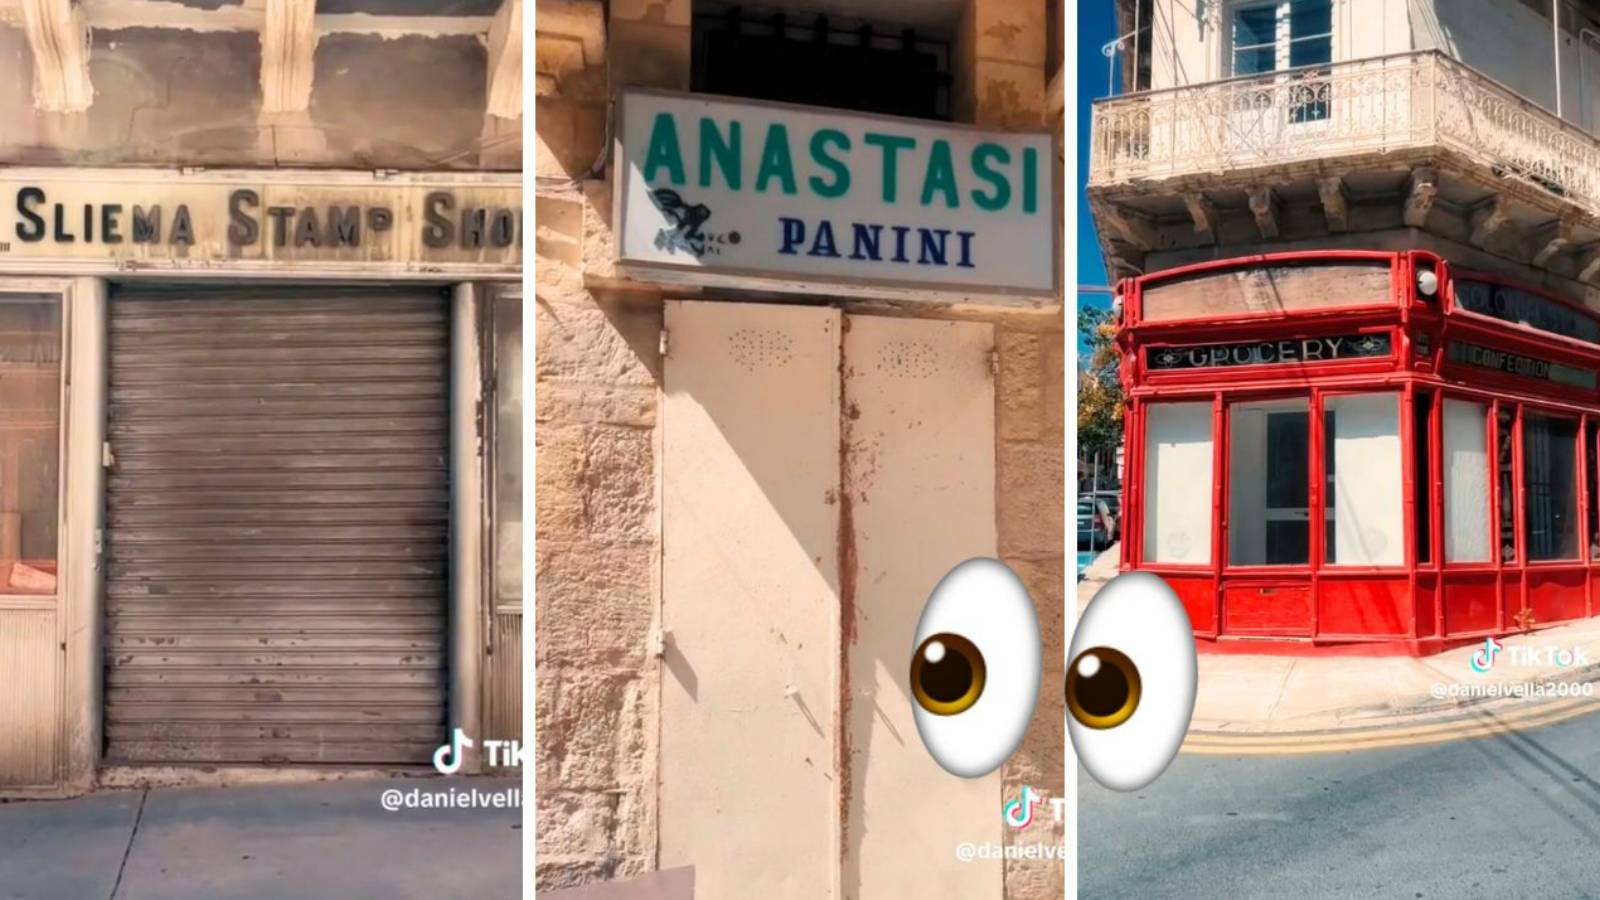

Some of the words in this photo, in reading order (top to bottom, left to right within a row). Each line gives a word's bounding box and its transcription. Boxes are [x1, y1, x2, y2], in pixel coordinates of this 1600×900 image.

[644, 112, 1038, 214] ANASTASI
[15, 186, 196, 244] SLIEMA
[227, 189, 393, 248] STAMP
[422, 191, 523, 251] SHO
[778, 216, 976, 268] PANINI
[1189, 337, 1344, 368] GROCERY
